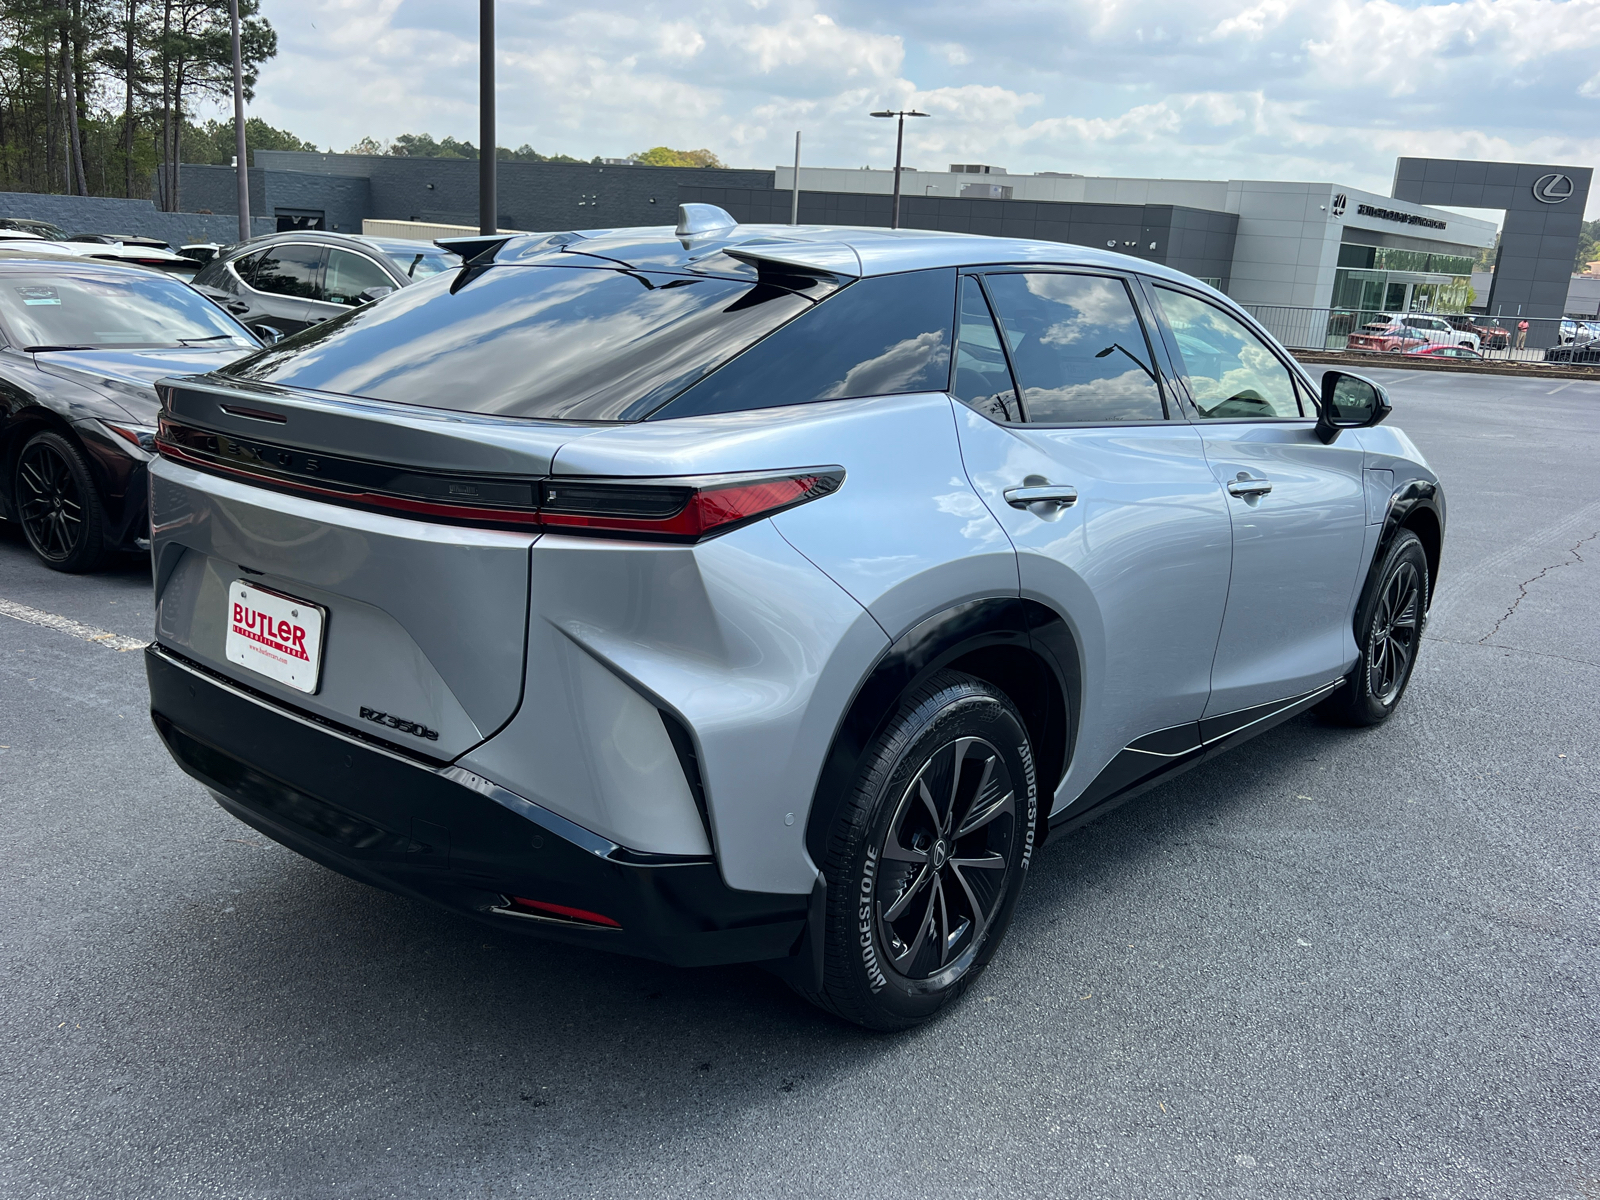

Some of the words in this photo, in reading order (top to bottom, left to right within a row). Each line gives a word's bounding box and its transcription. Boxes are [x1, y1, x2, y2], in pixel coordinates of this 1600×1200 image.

[359, 705, 439, 741] RZ350e
[1017, 738, 1038, 871] BRIDGESTONE
[859, 844, 888, 995] BRIDGESTONE
